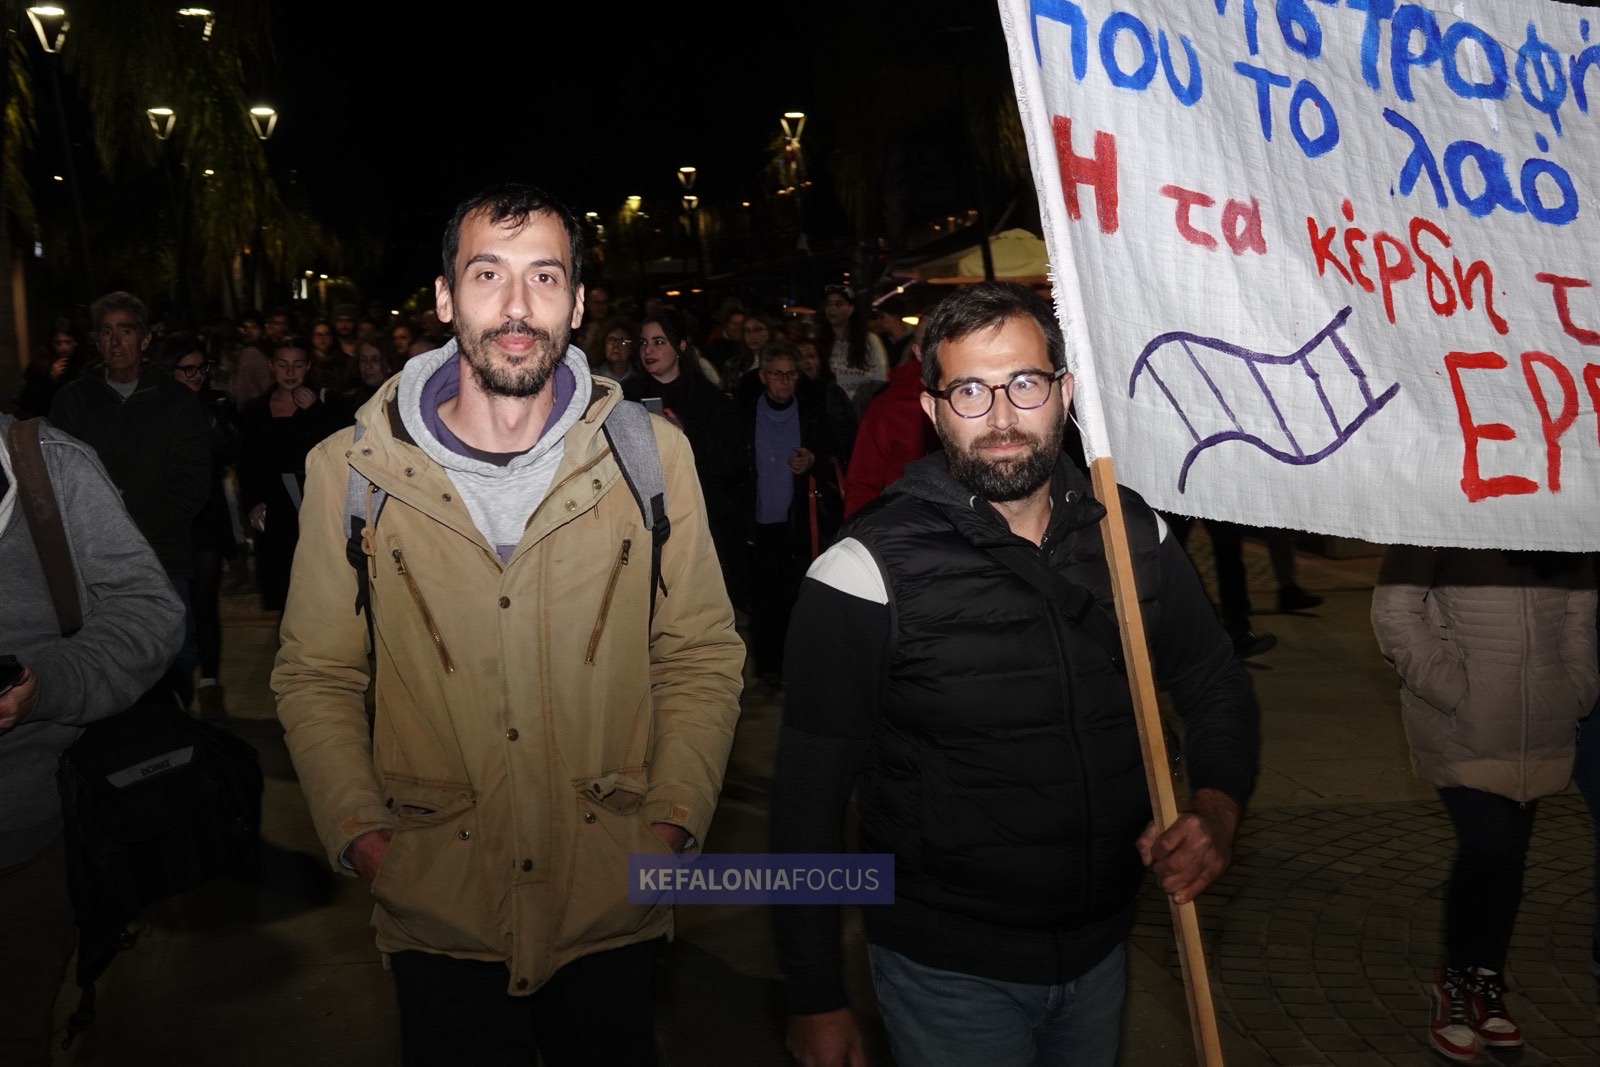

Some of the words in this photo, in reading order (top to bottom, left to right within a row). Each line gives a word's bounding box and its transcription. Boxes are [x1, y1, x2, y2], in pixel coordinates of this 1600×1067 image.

[1382, 106, 1580, 226] λαό
[1160, 184, 1267, 256] τα
[1306, 198, 1509, 336] κέρδη
